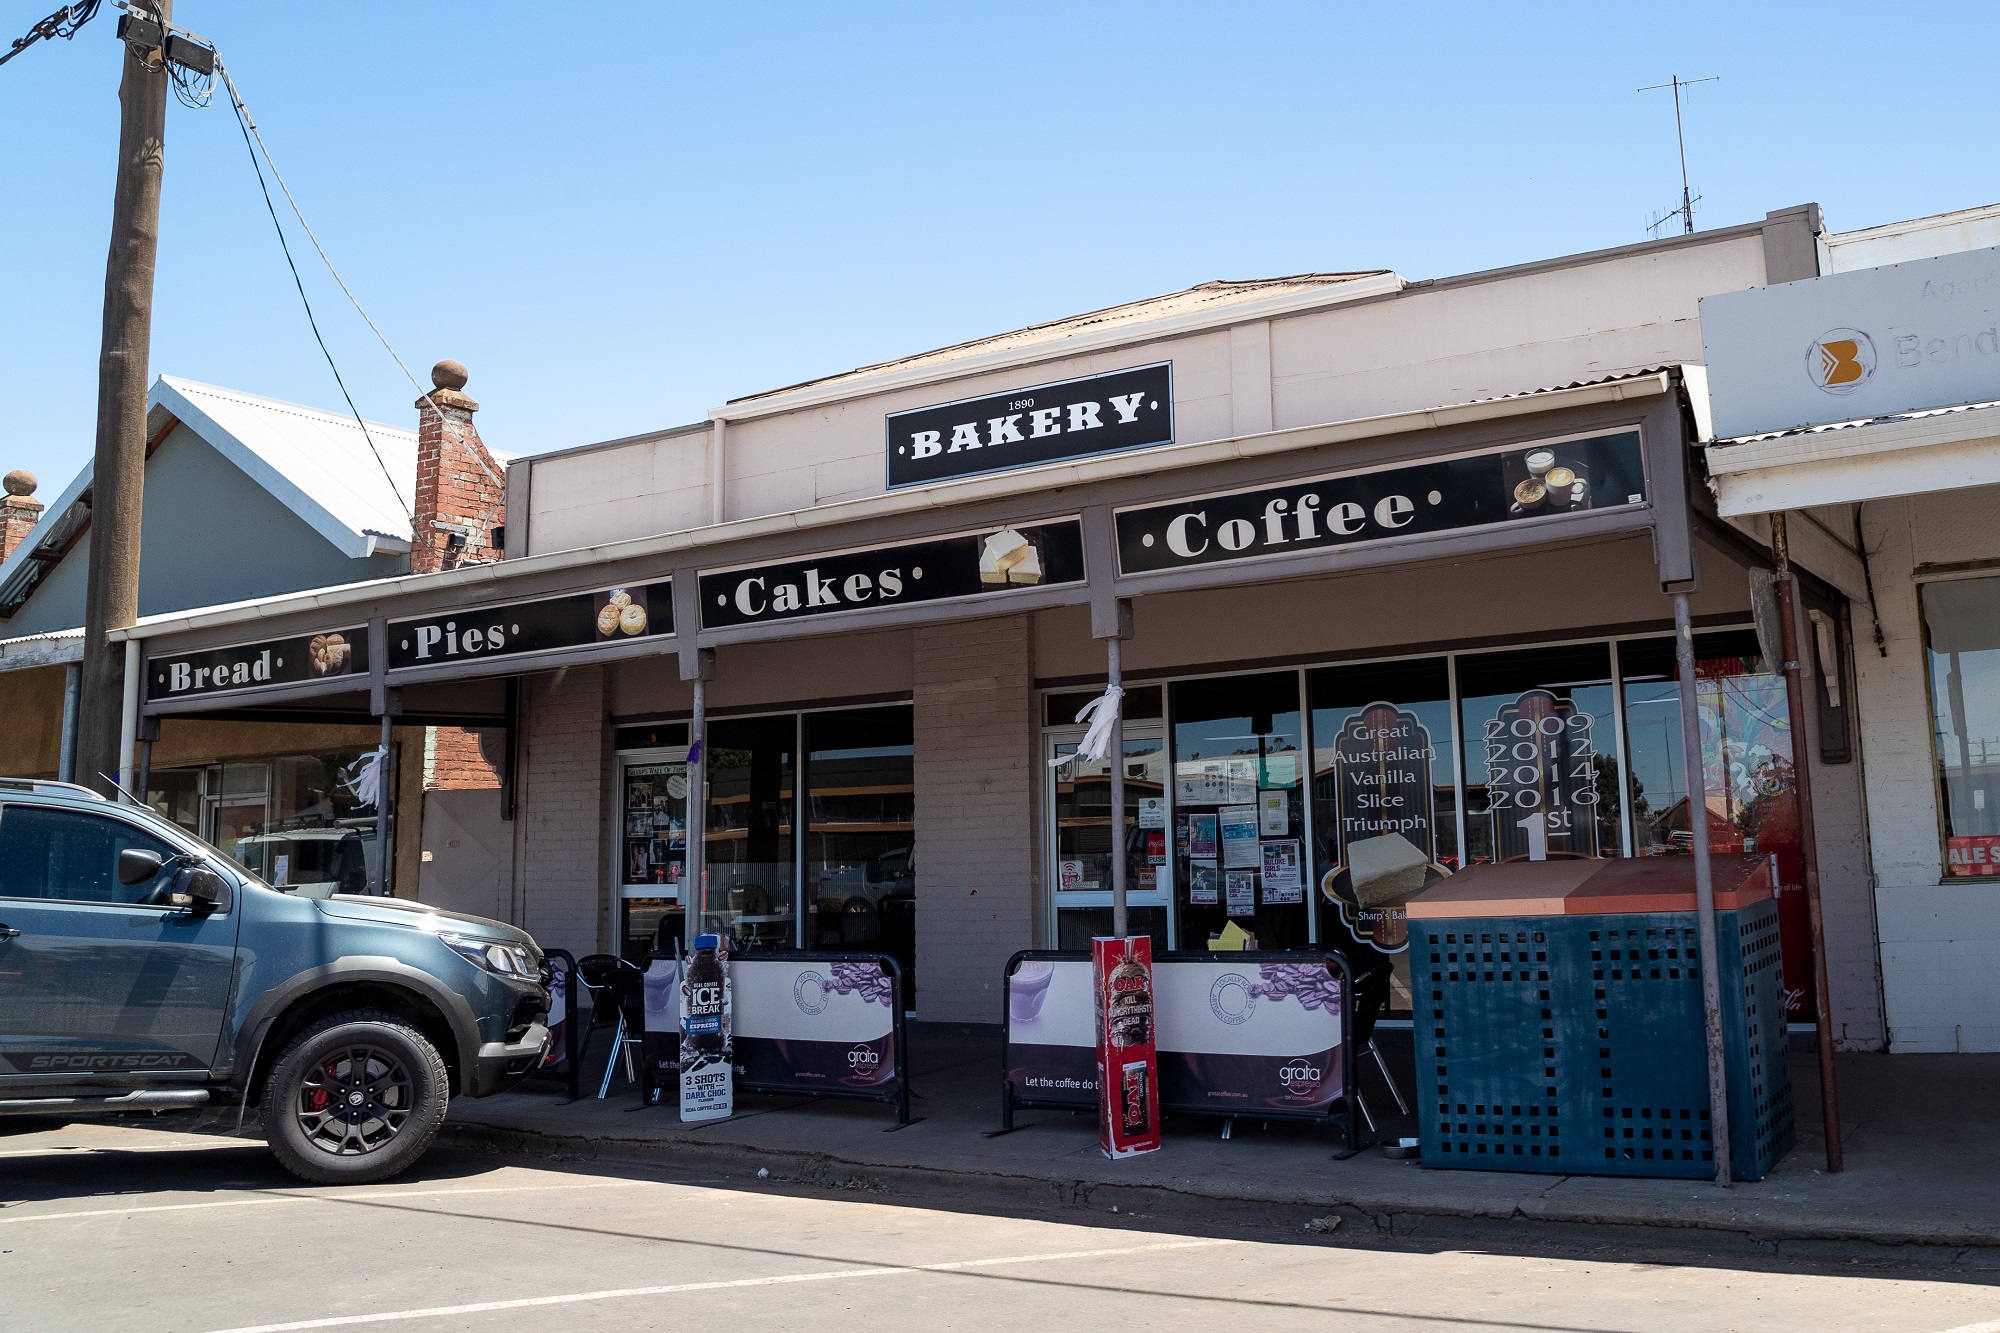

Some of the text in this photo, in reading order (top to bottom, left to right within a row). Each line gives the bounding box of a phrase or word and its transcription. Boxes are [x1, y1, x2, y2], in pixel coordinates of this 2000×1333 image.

[1008, 398, 1035, 411] 1890
[911, 392, 1145, 460] BAKERY
[1166, 494, 1414, 557] Coffee
[734, 567, 903, 616] Cakes
[415, 620, 505, 658] Pies
[168, 650, 271, 692] Bread
[1353, 725, 1409, 740] Great
[1485, 715, 1593, 740] 2009
[1333, 746, 1433, 764] Australian
[1486, 738, 1594, 763] 2012
[1350, 770, 1416, 786] Vanilla
[1488, 762, 1597, 787] 2014
[1357, 794, 1405, 808] Slice
[1489, 785, 1598, 810] 2016
[1342, 815, 1427, 833] Triumph
[1949, 847, 1986, 864] ALE
[1358, 910, 1407, 923] Sharp's Bak
[1113, 976, 1145, 991] OAK
[1217, 976, 1241, 988] LOCALLY
[692, 988, 720, 1006] ICE
[1124, 996, 1136, 1004] KILL
[692, 1004, 720, 1015] BREAK
[1123, 1017, 1140, 1025] DEAD
[1224, 1015, 1245, 1023] COFFEE
[30, 1055, 186, 1068] SPORTSCAT
[659, 1060, 669, 1069] Let
[848, 1050, 879, 1068] grata
[686, 1072, 726, 1085] 3 SHOTS
[1025, 1077, 1038, 1087] Let
[1040, 1077, 1053, 1087] the
[1055, 1078, 1080, 1089] coffee
[1082, 1079, 1093, 1089] do
[1280, 1065, 1320, 1086] grata
[1290, 1079, 1320, 1088] espresso
[686, 1088, 726, 1100] DARK CHOC
[1126, 1072, 1141, 1124] OAK
